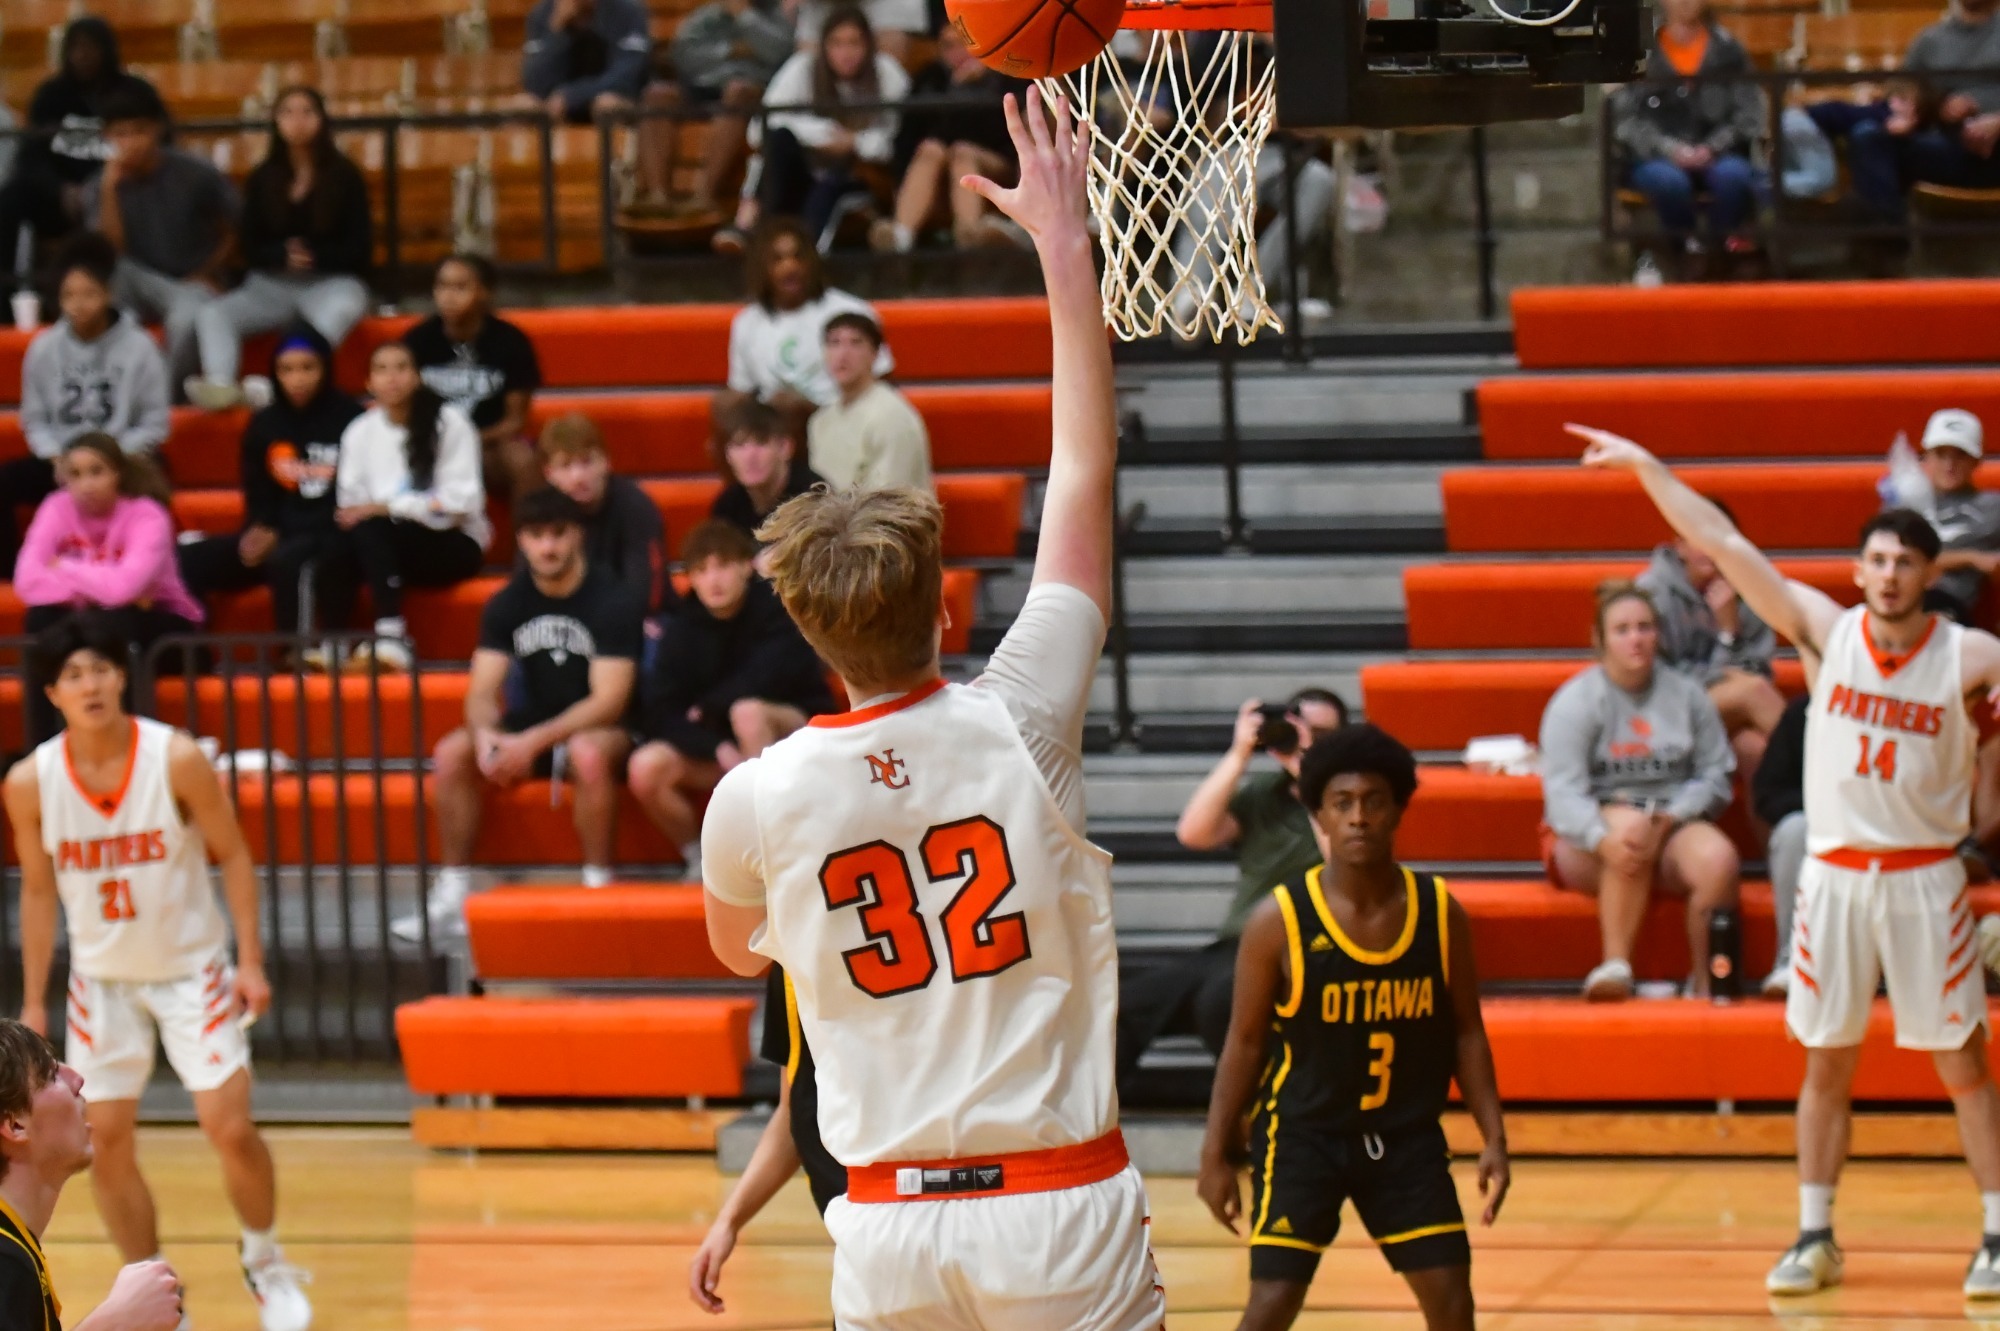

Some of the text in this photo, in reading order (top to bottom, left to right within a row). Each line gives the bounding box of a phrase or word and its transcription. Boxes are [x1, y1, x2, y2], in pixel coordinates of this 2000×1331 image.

[61, 379, 114, 425] 23
[1827, 684, 1946, 738] PANTHERS
[864, 748, 911, 790] NC
[1856, 734, 1897, 782] 14
[58, 828, 165, 872] PANTHERS
[99, 878, 137, 921] 21
[817, 814, 1032, 999] 32
[1321, 976, 1433, 1024] OTTAWA
[1359, 1031, 1395, 1111] 3
